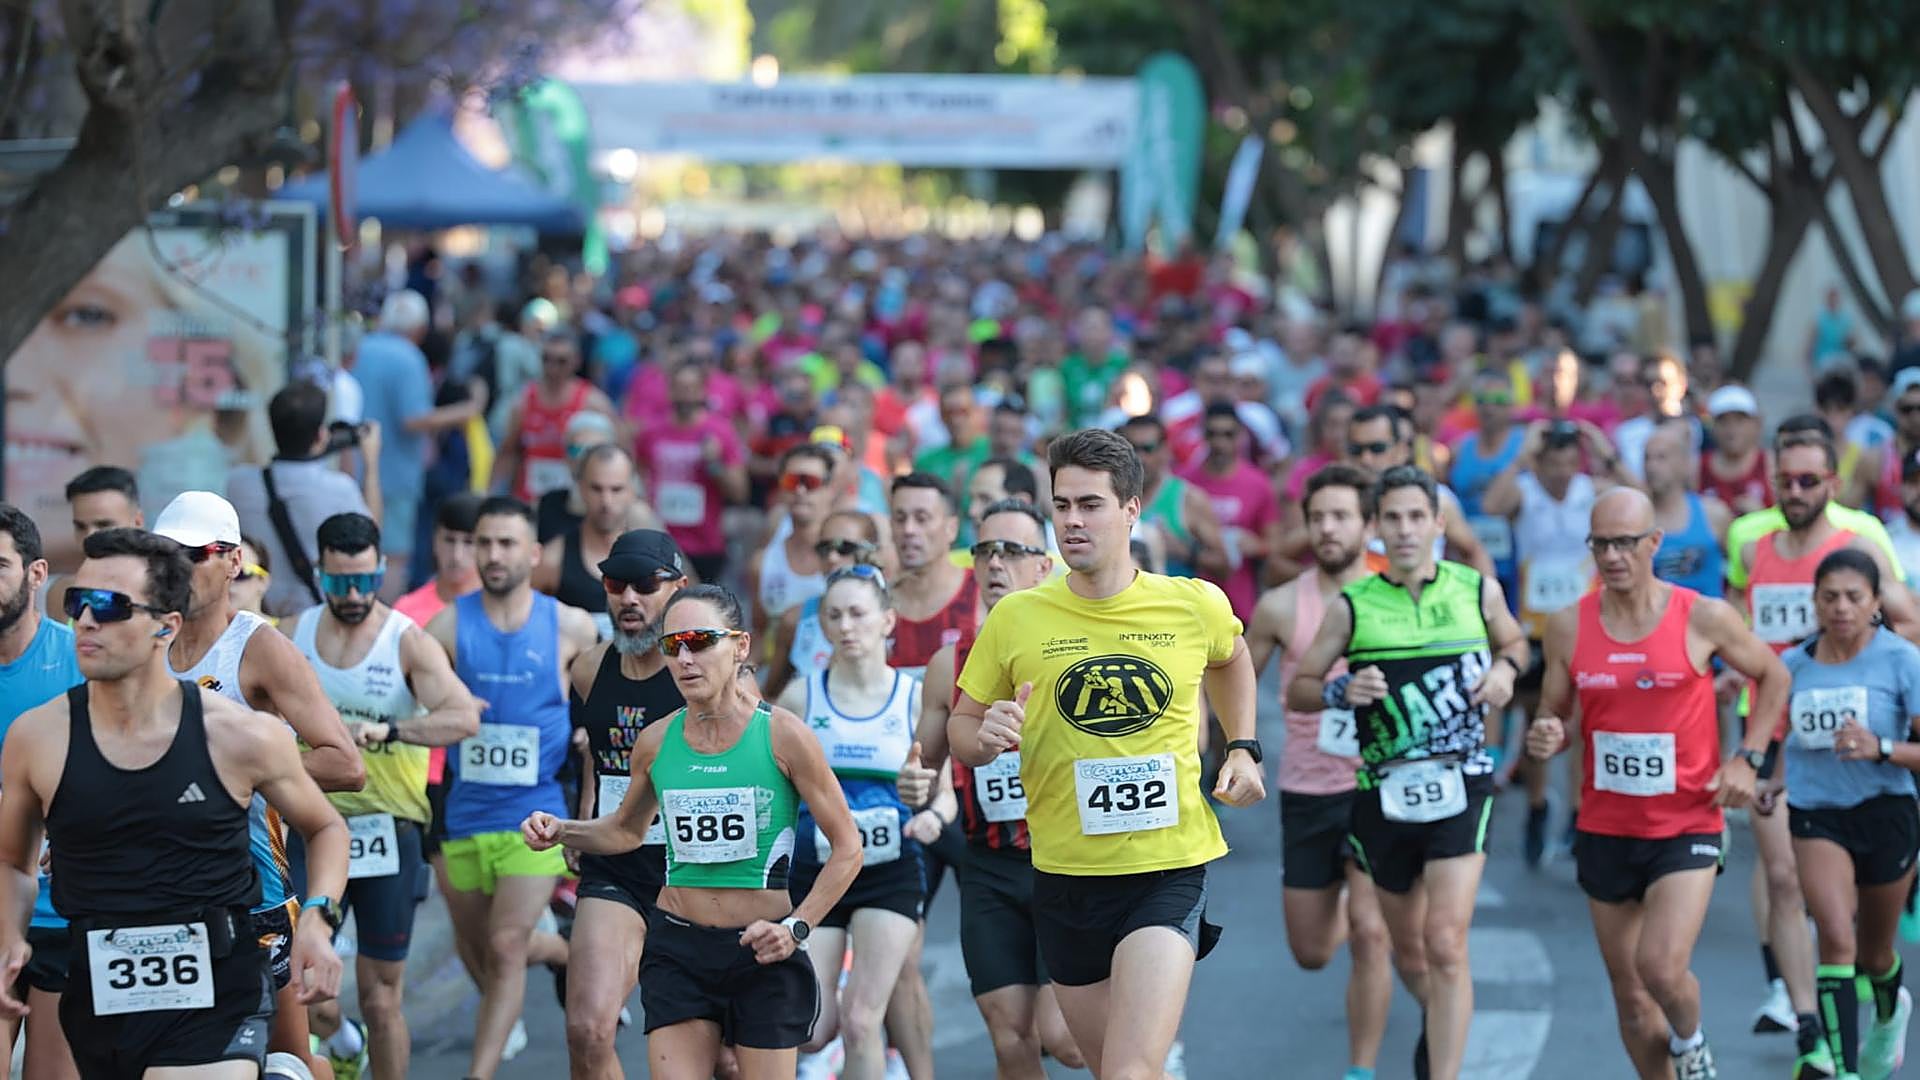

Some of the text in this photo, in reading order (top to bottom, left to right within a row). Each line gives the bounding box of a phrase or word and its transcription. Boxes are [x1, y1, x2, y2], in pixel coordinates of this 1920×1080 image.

[1761, 604, 1808, 626] 611
[1119, 632, 1176, 641] INTENXITY
[1150, 640, 1176, 648] SPORT
[616, 705, 647, 728] WE
[608, 726, 642, 749] RU
[469, 744, 529, 769] 306
[1604, 753, 1664, 778] 669
[986, 775, 1027, 803] 55
[1087, 780, 1167, 813] 432
[1404, 782, 1442, 807] 59
[675, 814, 746, 843] 586
[349, 836, 388, 860] 94
[108, 954, 199, 990] 336
